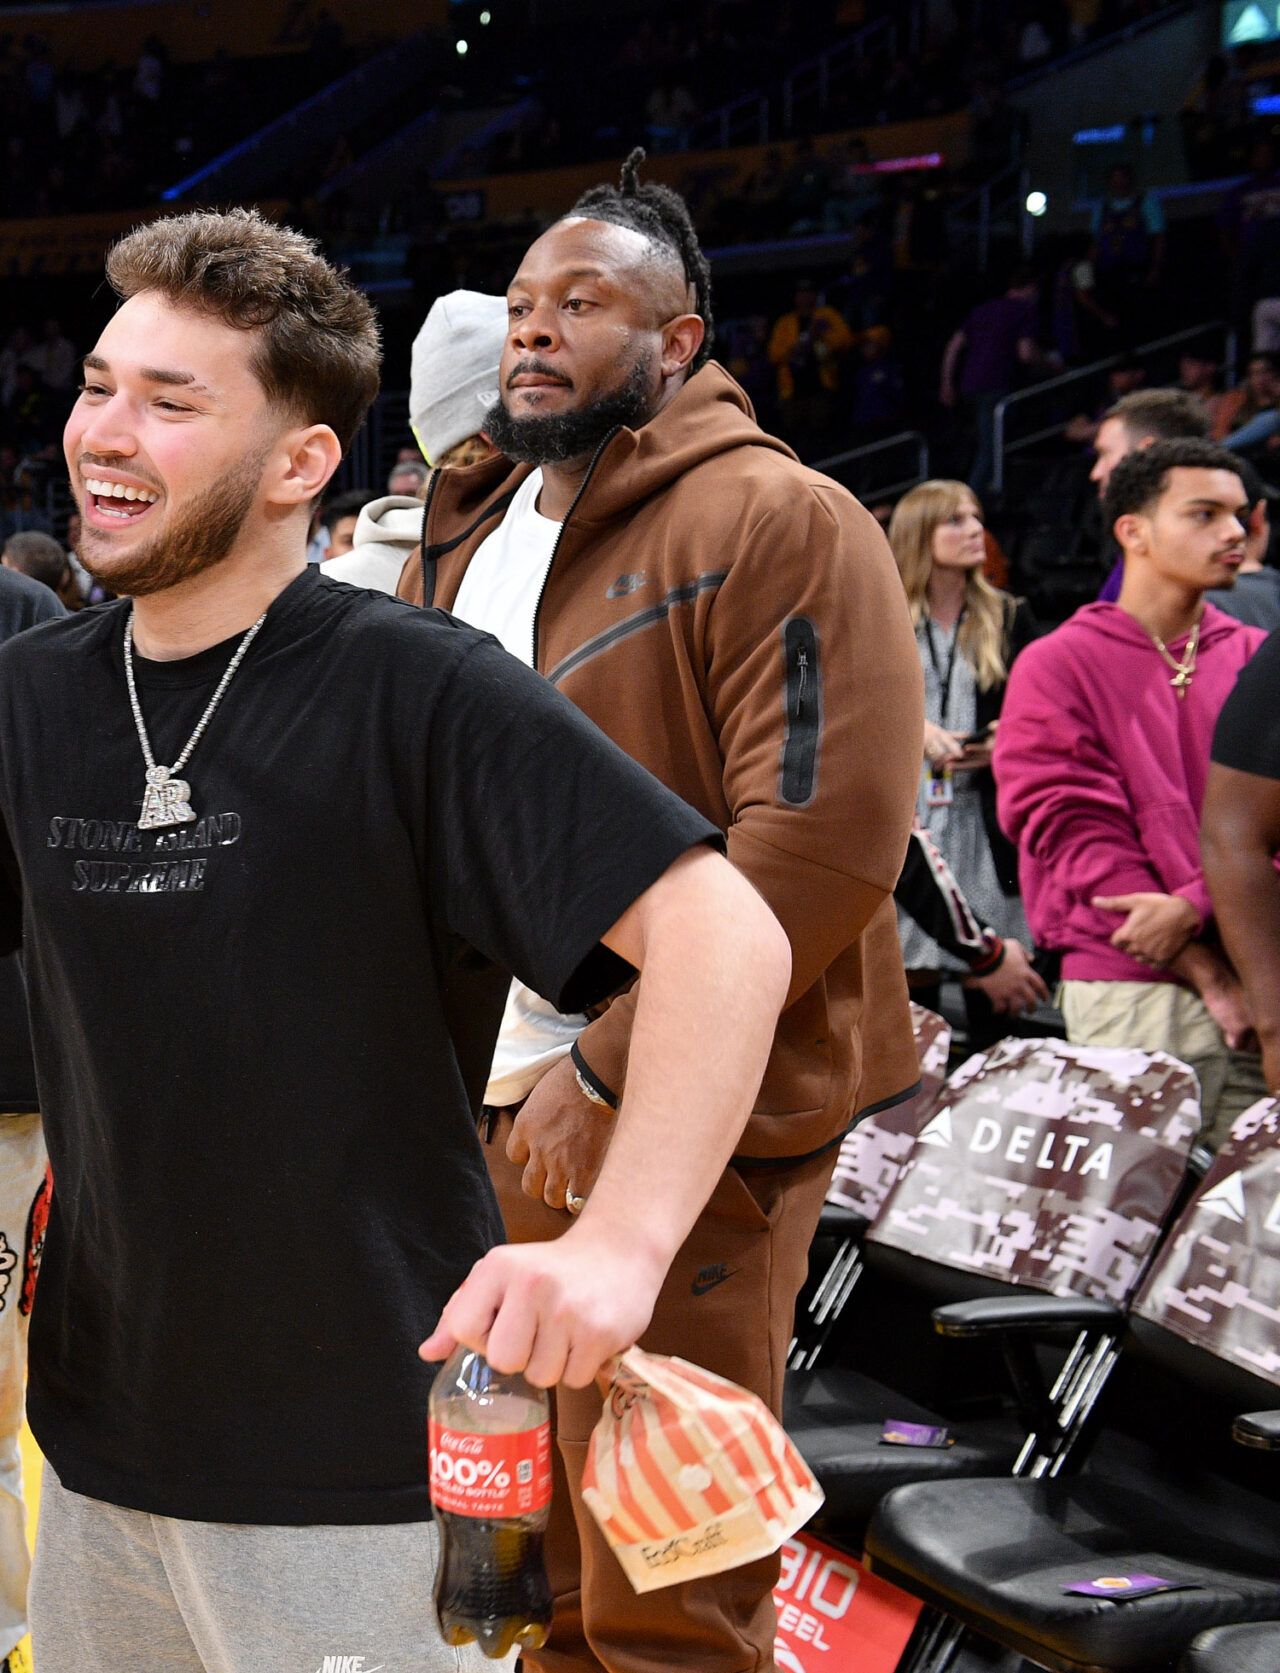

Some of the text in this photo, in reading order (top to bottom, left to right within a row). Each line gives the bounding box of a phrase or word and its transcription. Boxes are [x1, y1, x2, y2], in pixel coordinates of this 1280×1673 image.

[47, 815, 143, 853] STONE
[72, 857, 208, 893] SUPREME
[969, 1116, 1115, 1180] DELTA
[429, 1447, 511, 1488] 100%
[775, 1537, 859, 1620] BIO
[322, 1655, 366, 1673] NIKE
